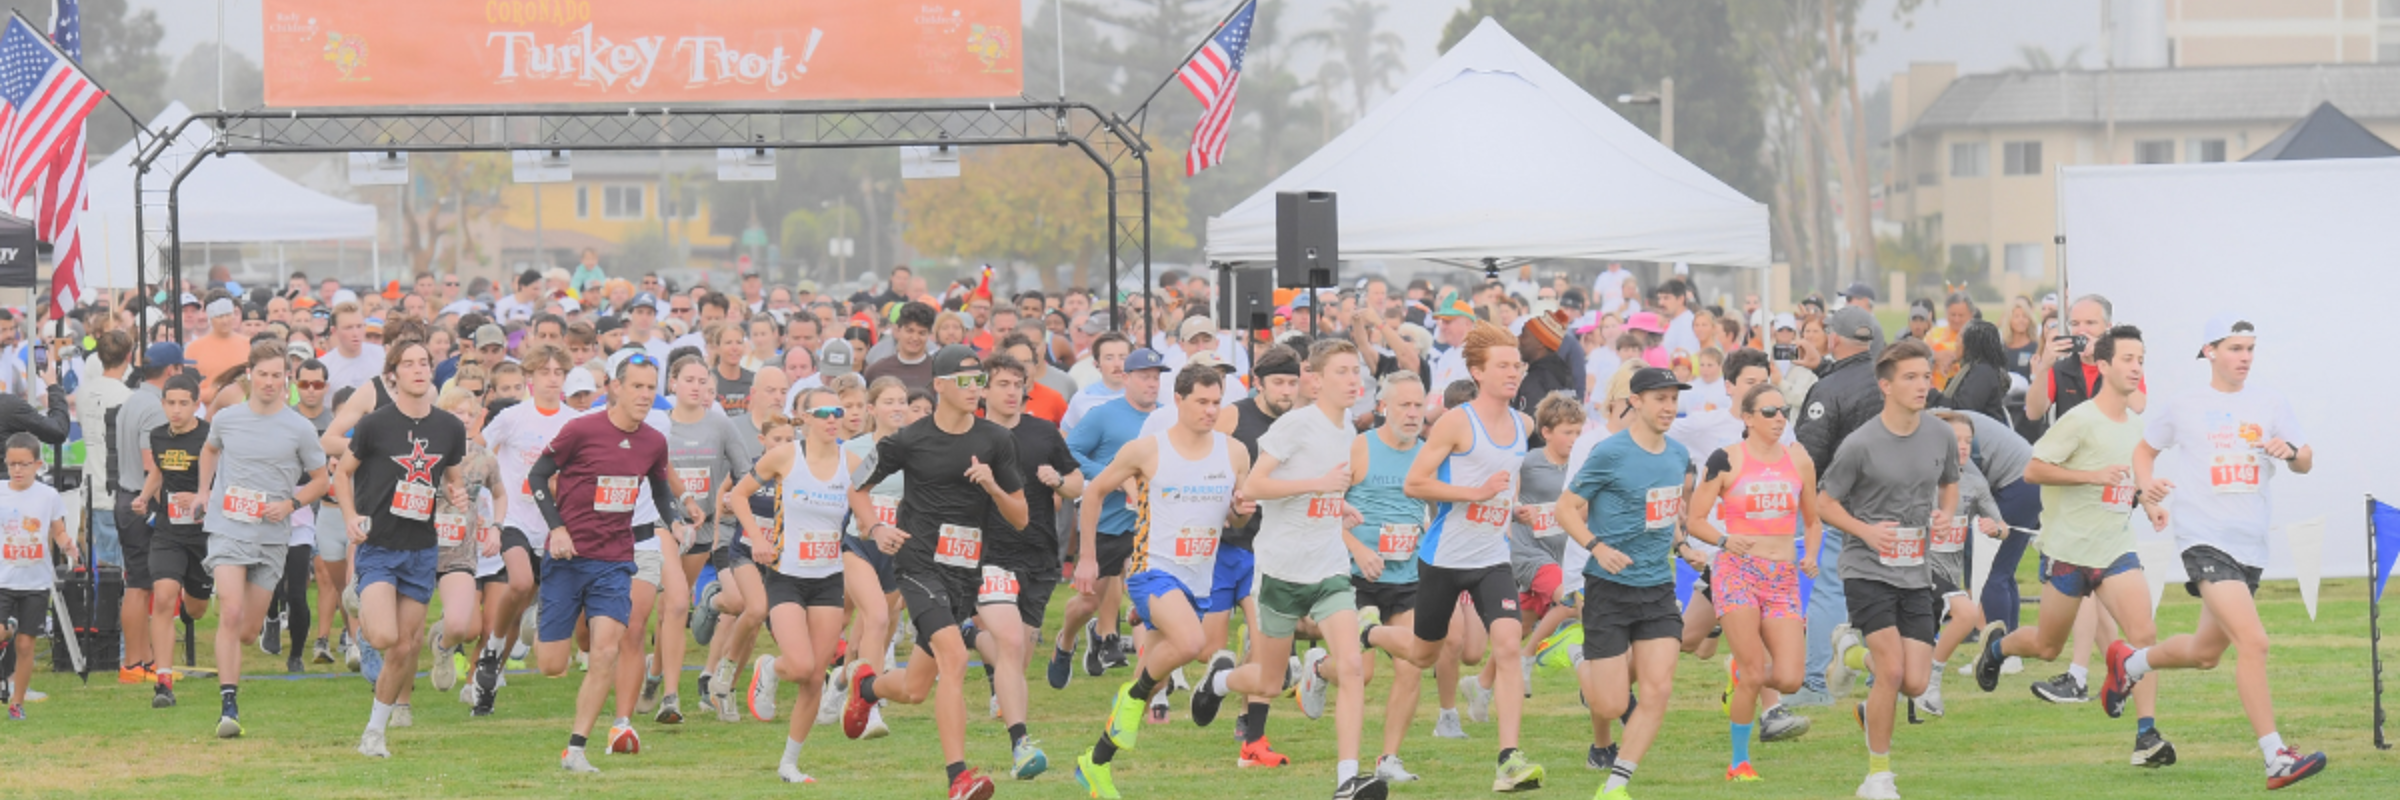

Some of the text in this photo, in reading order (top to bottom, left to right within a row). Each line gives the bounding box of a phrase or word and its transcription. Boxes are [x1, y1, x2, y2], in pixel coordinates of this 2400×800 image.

[486, 0, 592, 27] CORONADO
[486, 22, 824, 90] Turkey Trot!
[2219, 466, 2254, 482] 1149
[1183, 485, 1230, 495] PARROT
[1754, 493, 1787, 510] 1644
[808, 543, 837, 557] 1503
[946, 539, 976, 557] 1579
[1184, 539, 1213, 554] 1505
